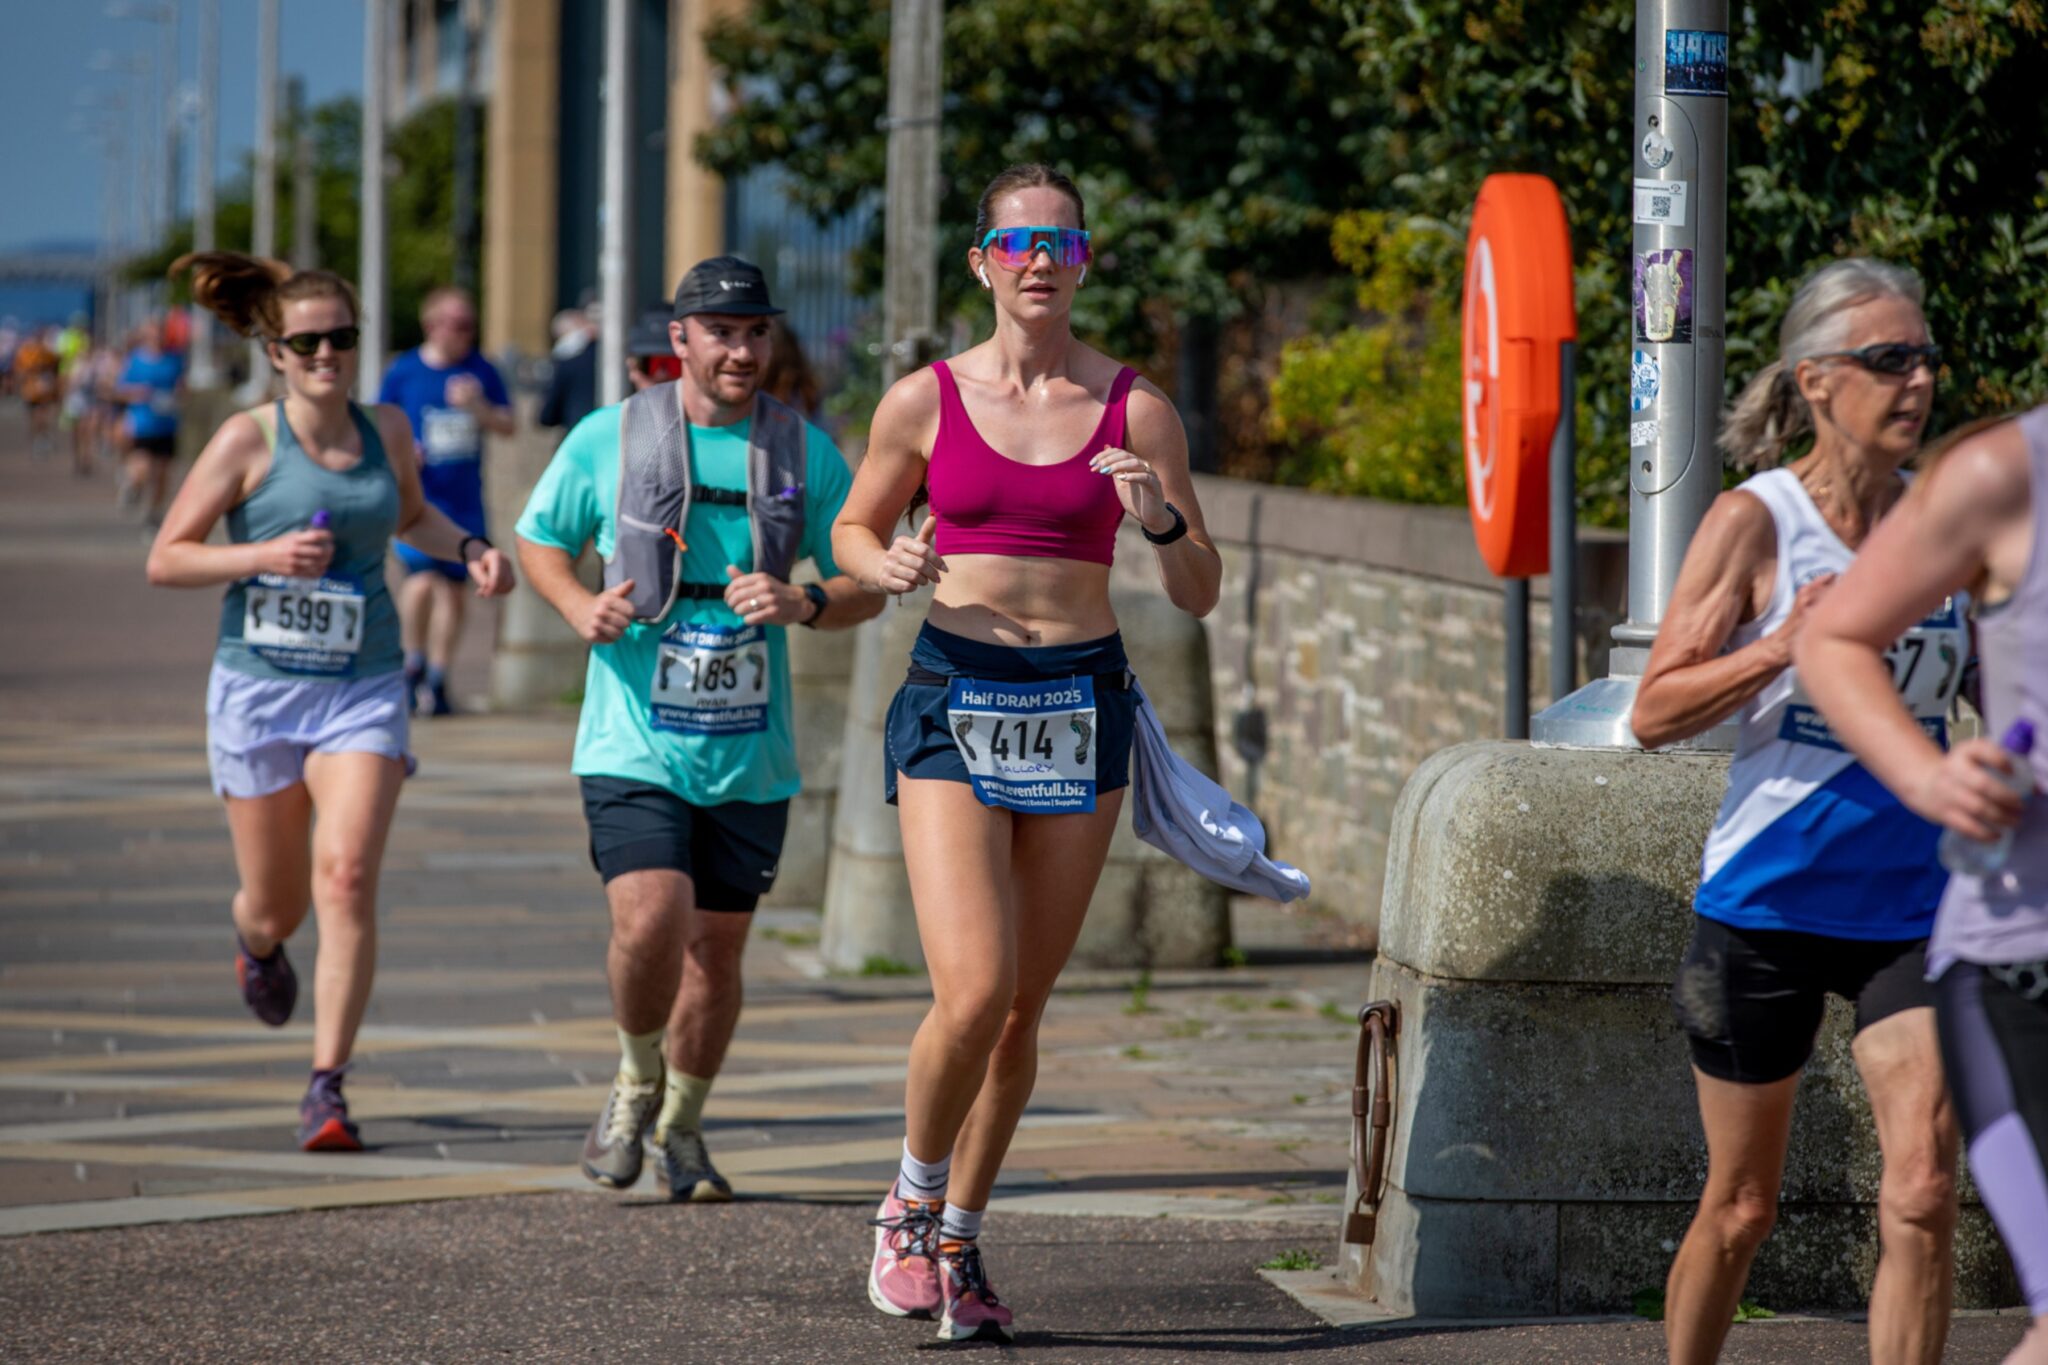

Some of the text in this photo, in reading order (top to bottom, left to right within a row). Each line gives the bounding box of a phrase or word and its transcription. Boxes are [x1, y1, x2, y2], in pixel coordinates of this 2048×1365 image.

[278, 596, 331, 634] 599
[690, 654, 738, 693] 185
[961, 690, 1083, 708] Half DRAM 2025
[990, 719, 1053, 760] 414
[979, 780, 1087, 798] www.eventfull.biz
[1055, 799, 1083, 807] Supplies
